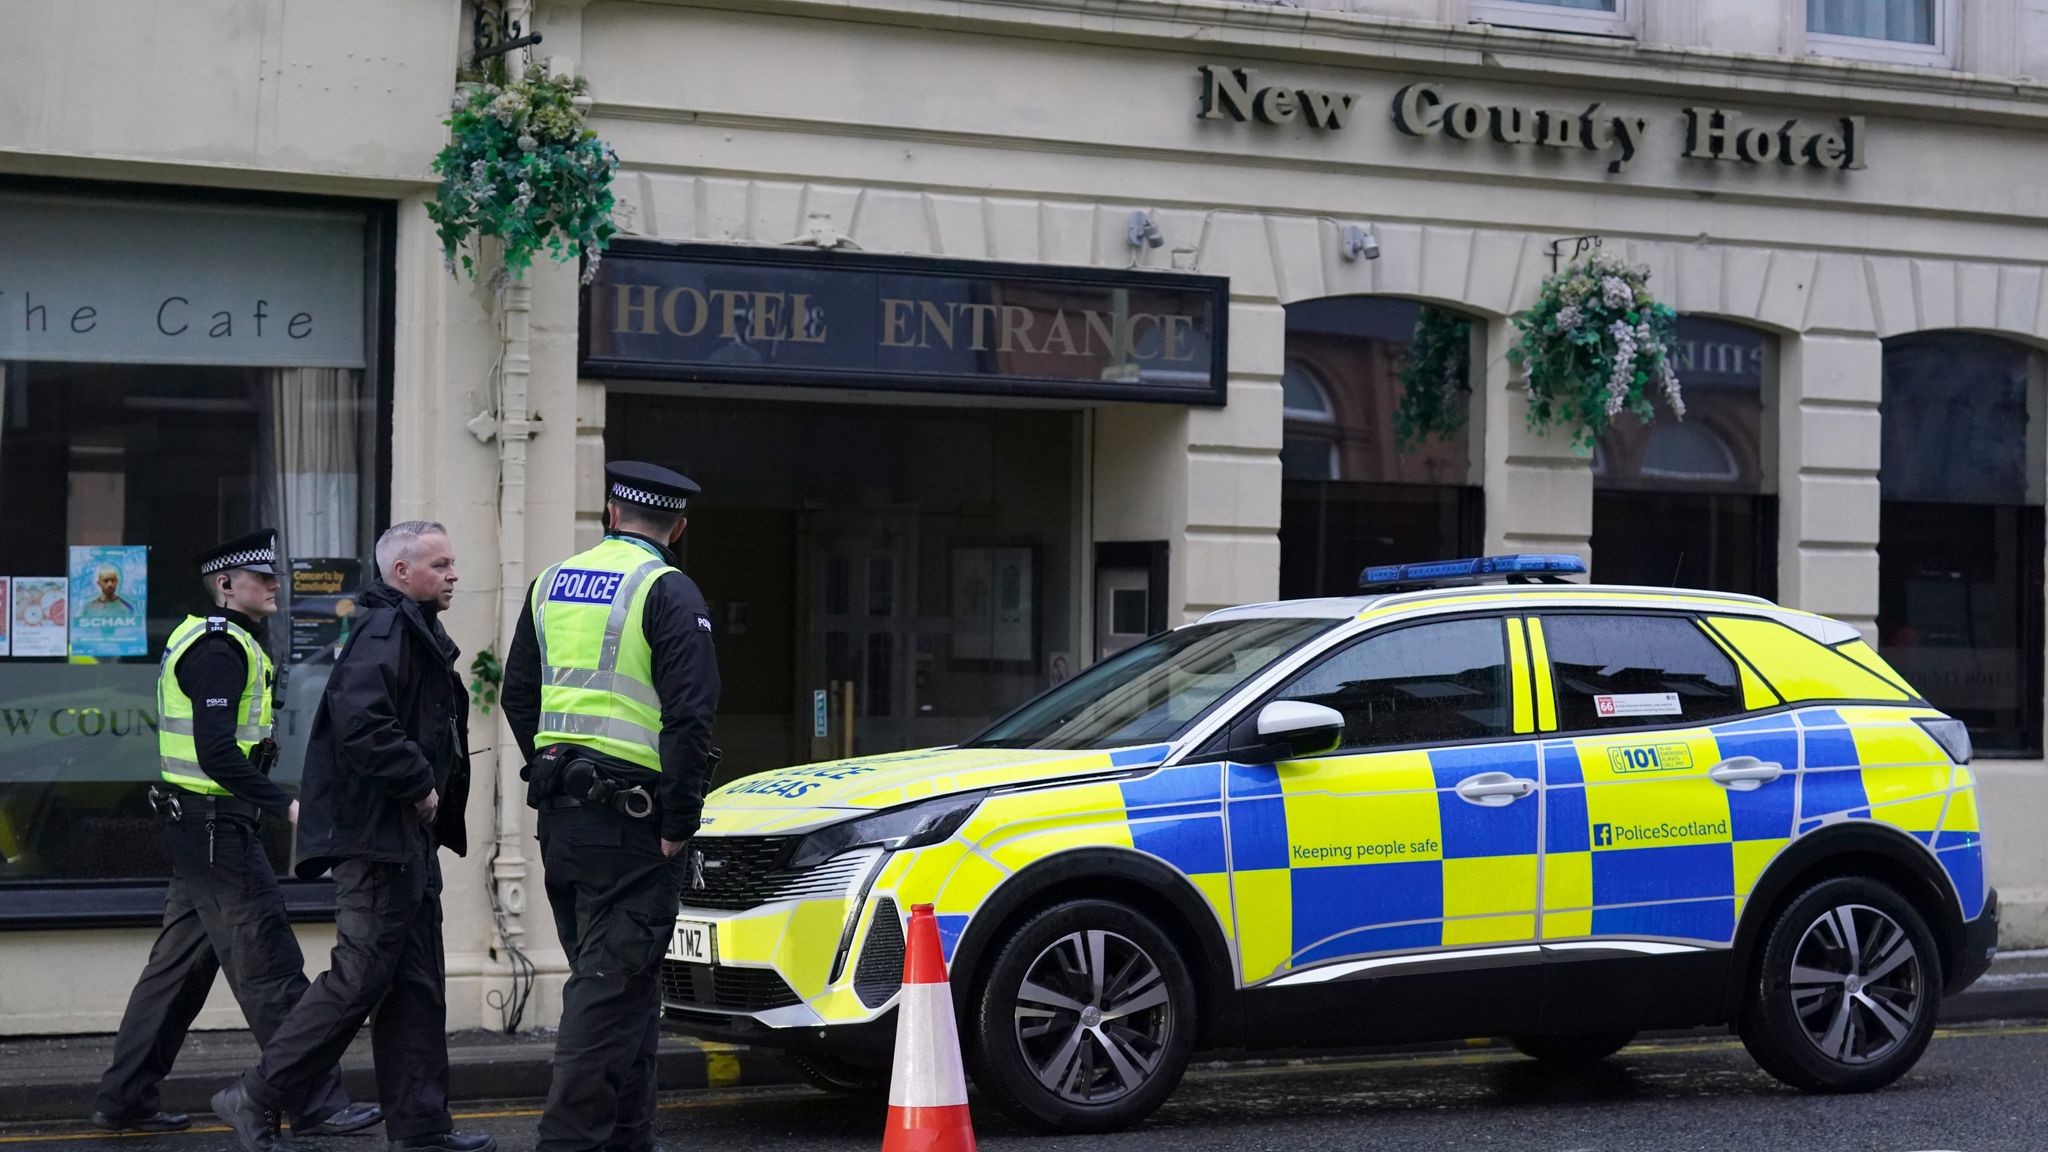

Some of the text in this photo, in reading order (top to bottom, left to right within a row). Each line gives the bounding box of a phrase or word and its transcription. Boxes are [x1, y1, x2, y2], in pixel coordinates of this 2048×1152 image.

[1196, 65, 1868, 173] New County Hotel
[0, 292, 313, 339] he Cafe
[612, 284, 828, 343] HOTEL
[880, 299, 1194, 361] ENTRANCE
[552, 573, 620, 600] POLICE
[79, 617, 136, 627] SCHAK
[1600, 702, 1613, 711] 66
[48, 707, 160, 737] COUN
[1624, 748, 1659, 768] 101
[1615, 819, 1728, 841] PoliceScotland
[1292, 838, 1438, 861] Keeping people safe
[678, 928, 703, 958] TMZ
